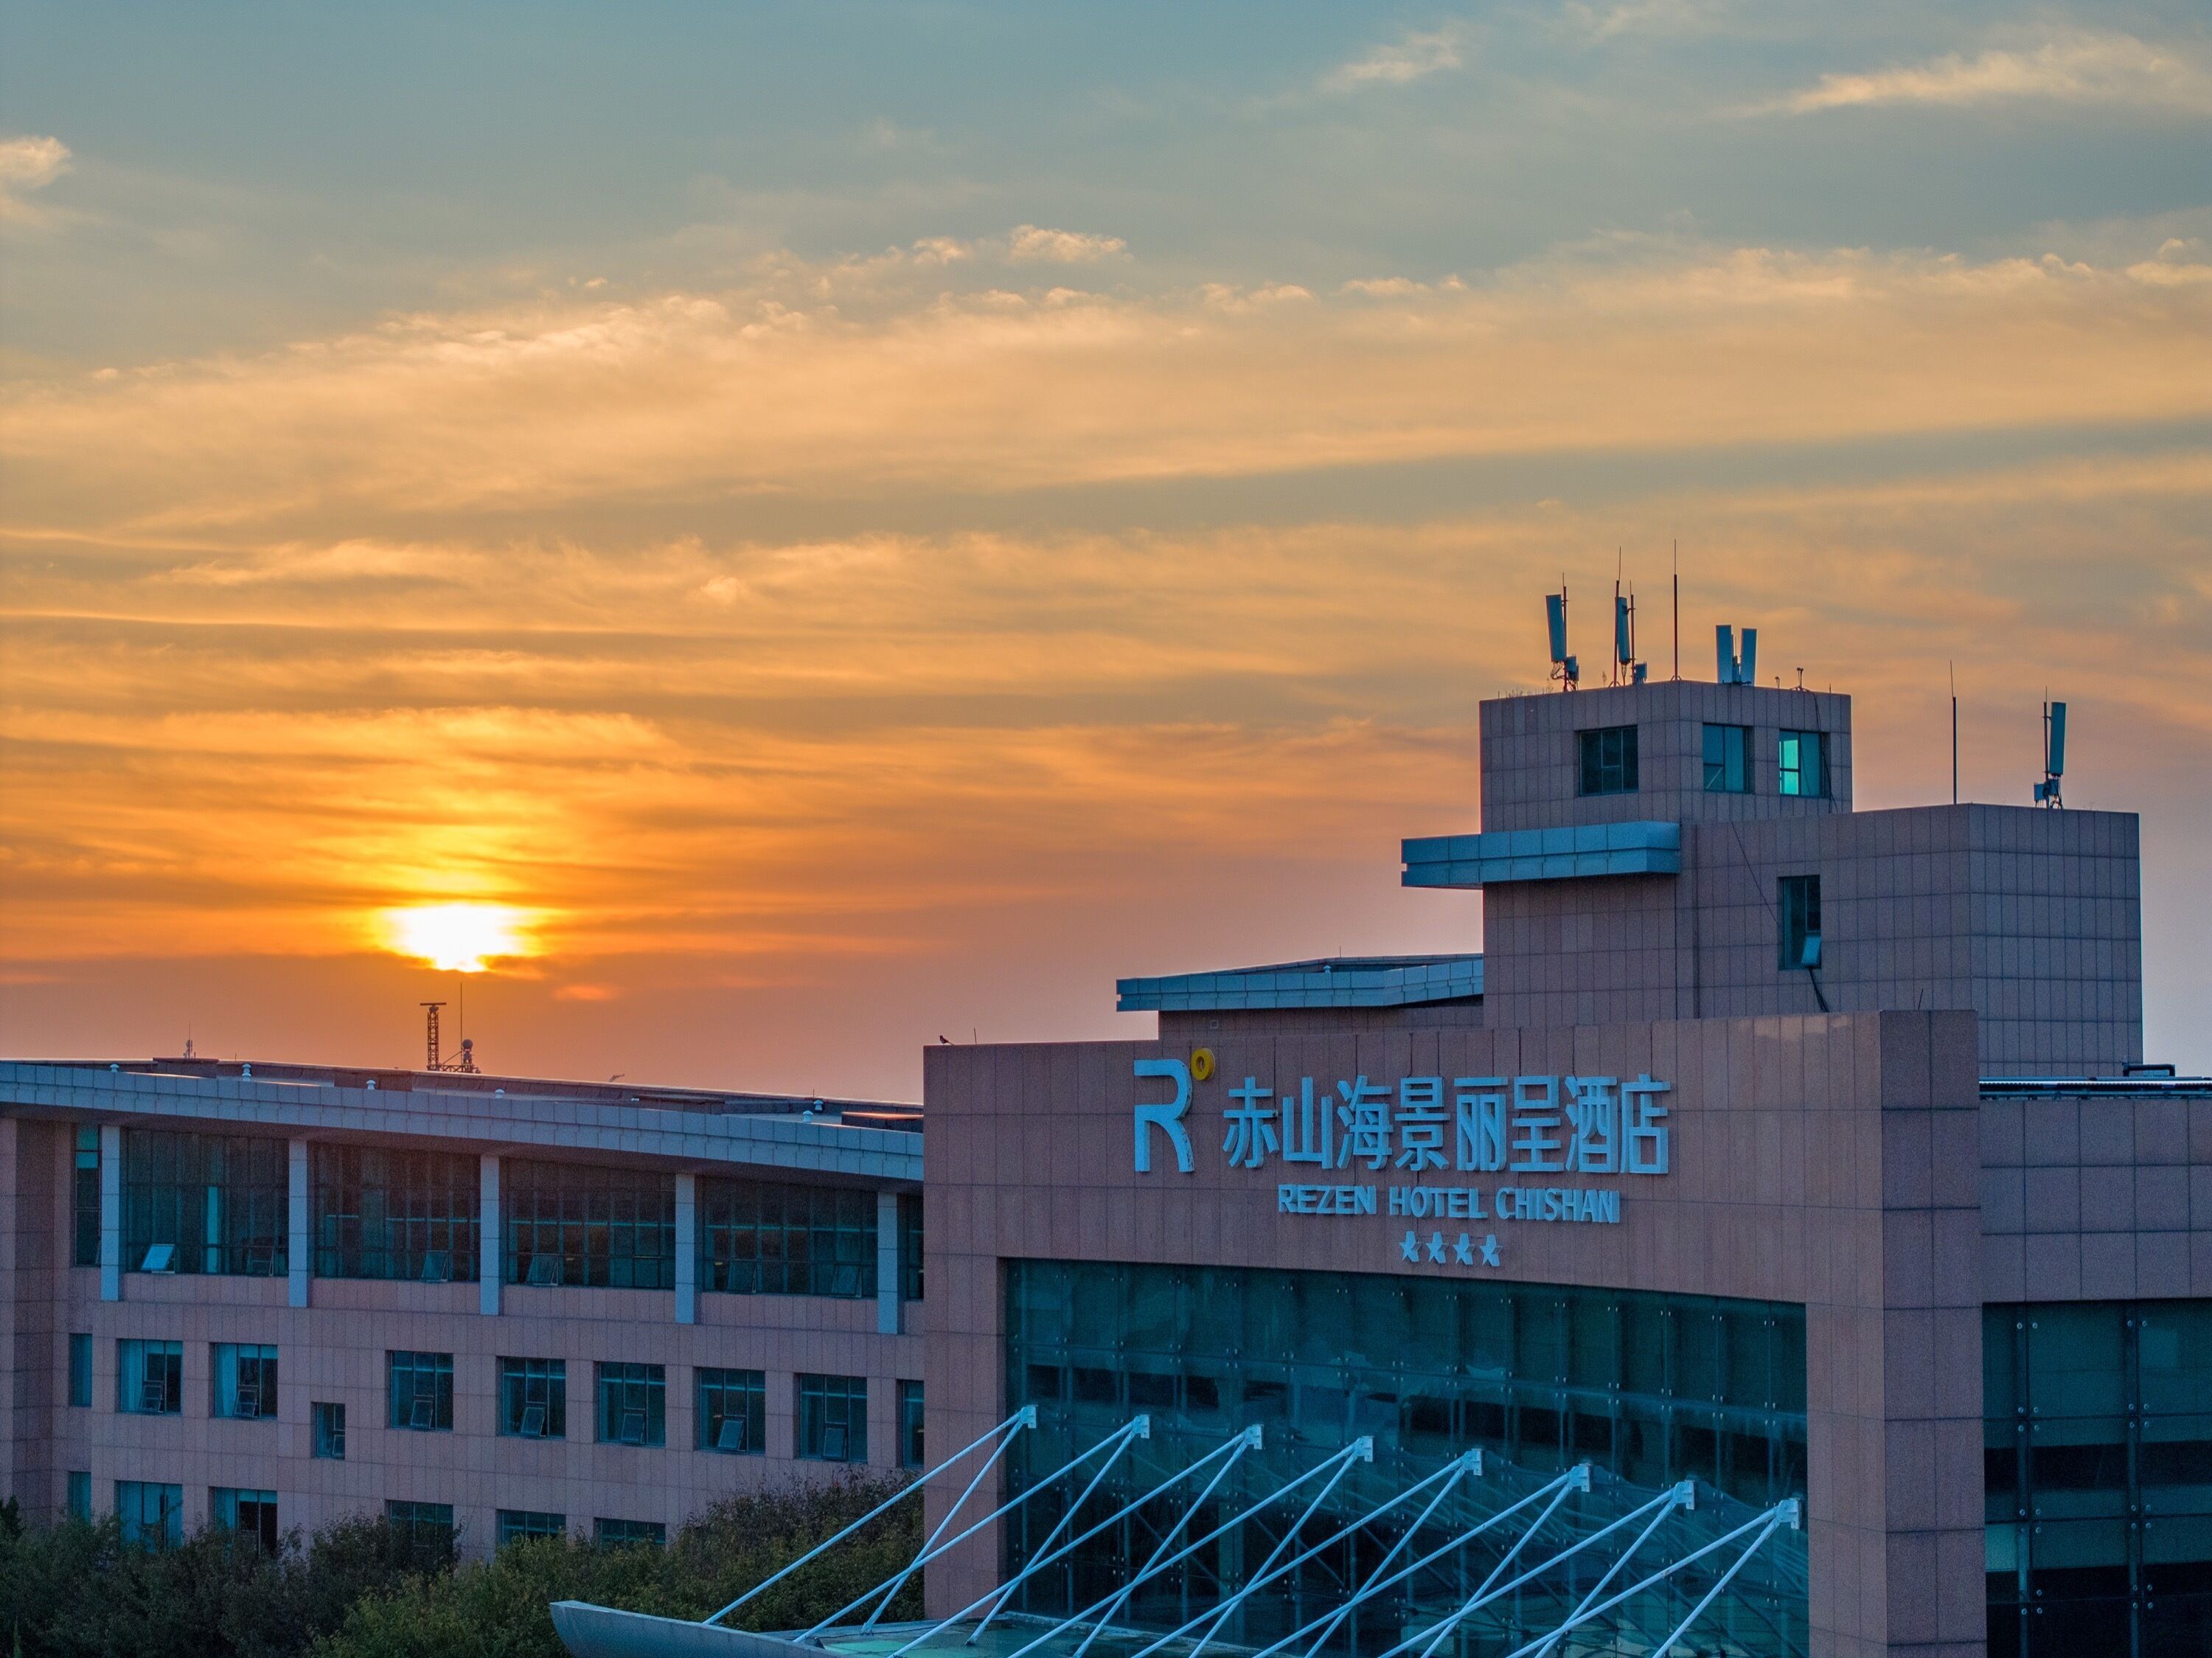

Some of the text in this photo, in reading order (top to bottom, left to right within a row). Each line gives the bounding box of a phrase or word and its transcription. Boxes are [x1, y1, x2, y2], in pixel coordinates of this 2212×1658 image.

[1222, 1073, 1671, 1174] 赤山海景丽呈酒店
[1278, 1183, 1620, 1224] REZEN HOTEL CHISHAN
